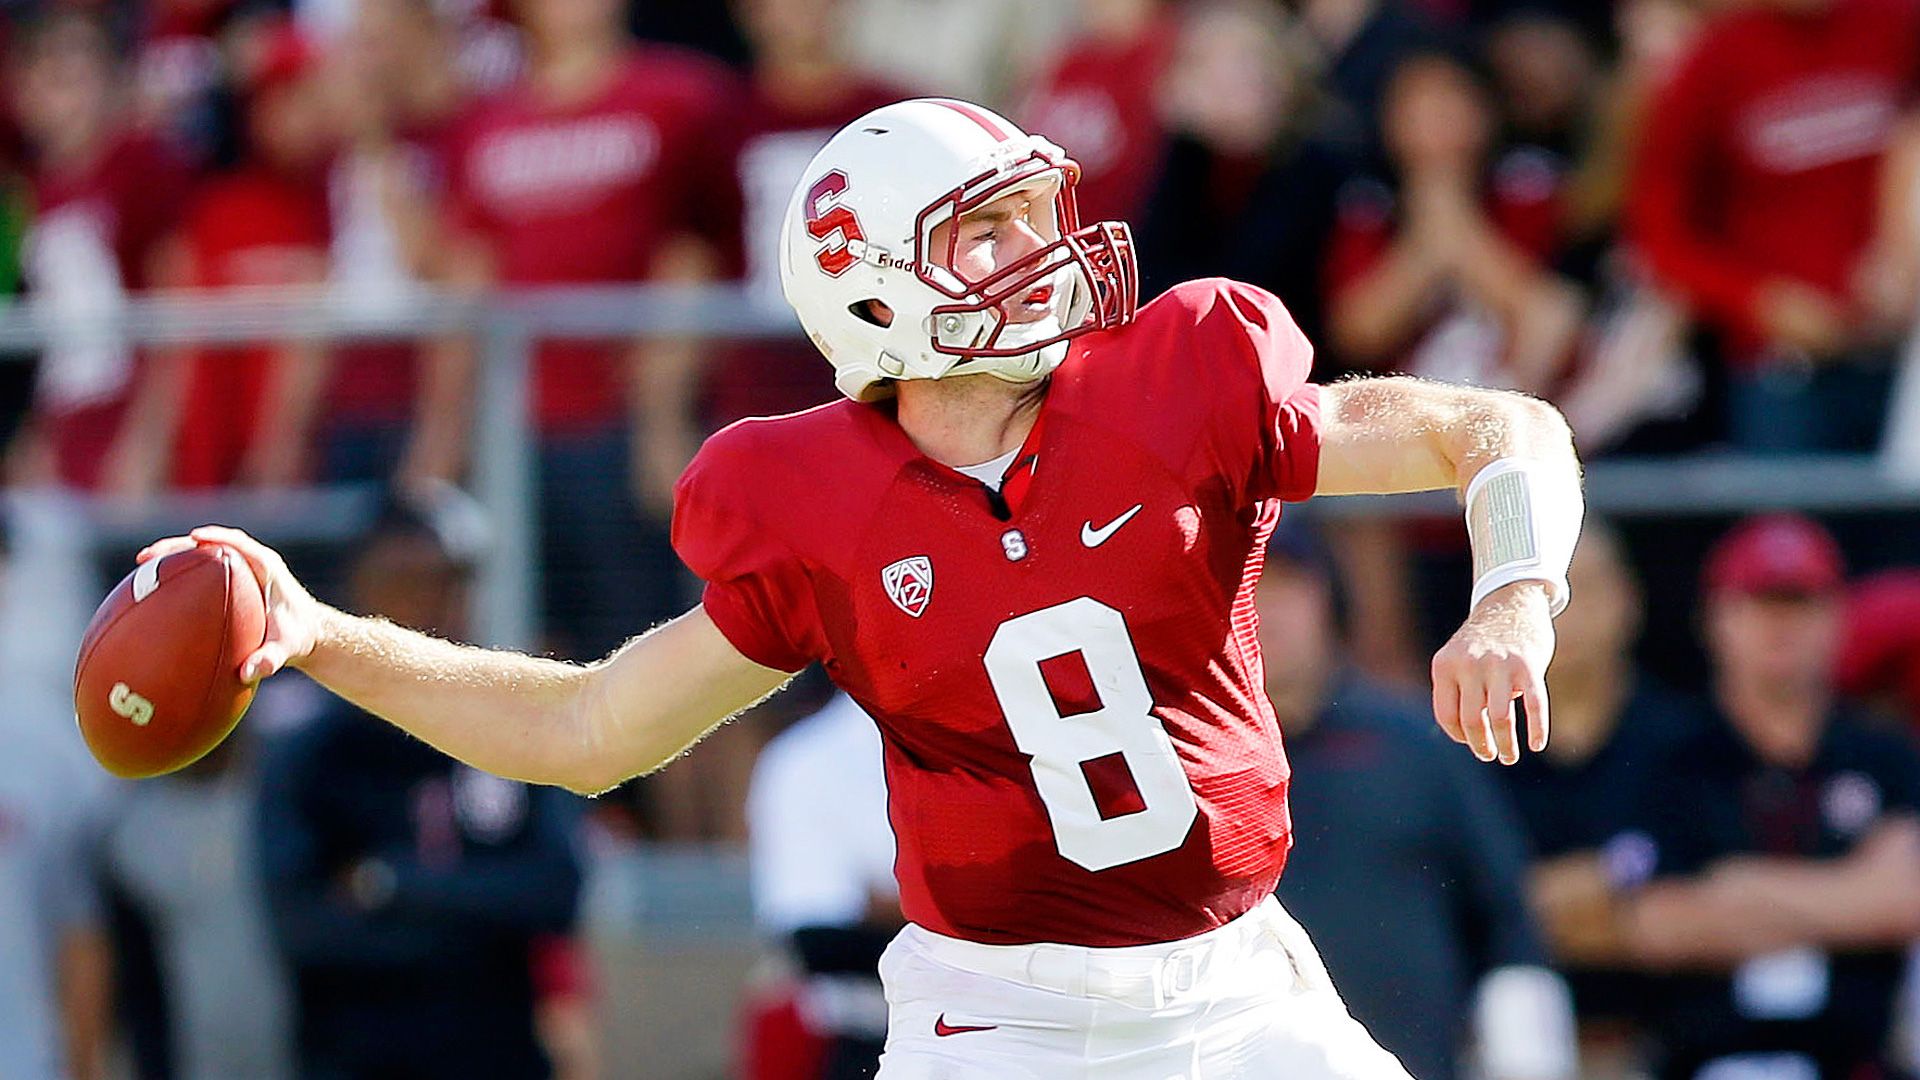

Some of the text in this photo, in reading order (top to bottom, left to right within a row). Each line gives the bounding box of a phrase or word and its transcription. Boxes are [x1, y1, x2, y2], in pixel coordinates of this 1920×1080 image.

[804, 168, 868, 278] S
[1001, 529, 1027, 561] S
[885, 561, 929, 599] PAC
[900, 581, 925, 607] 12
[108, 681, 155, 727] S
[983, 596, 1199, 872] 8
